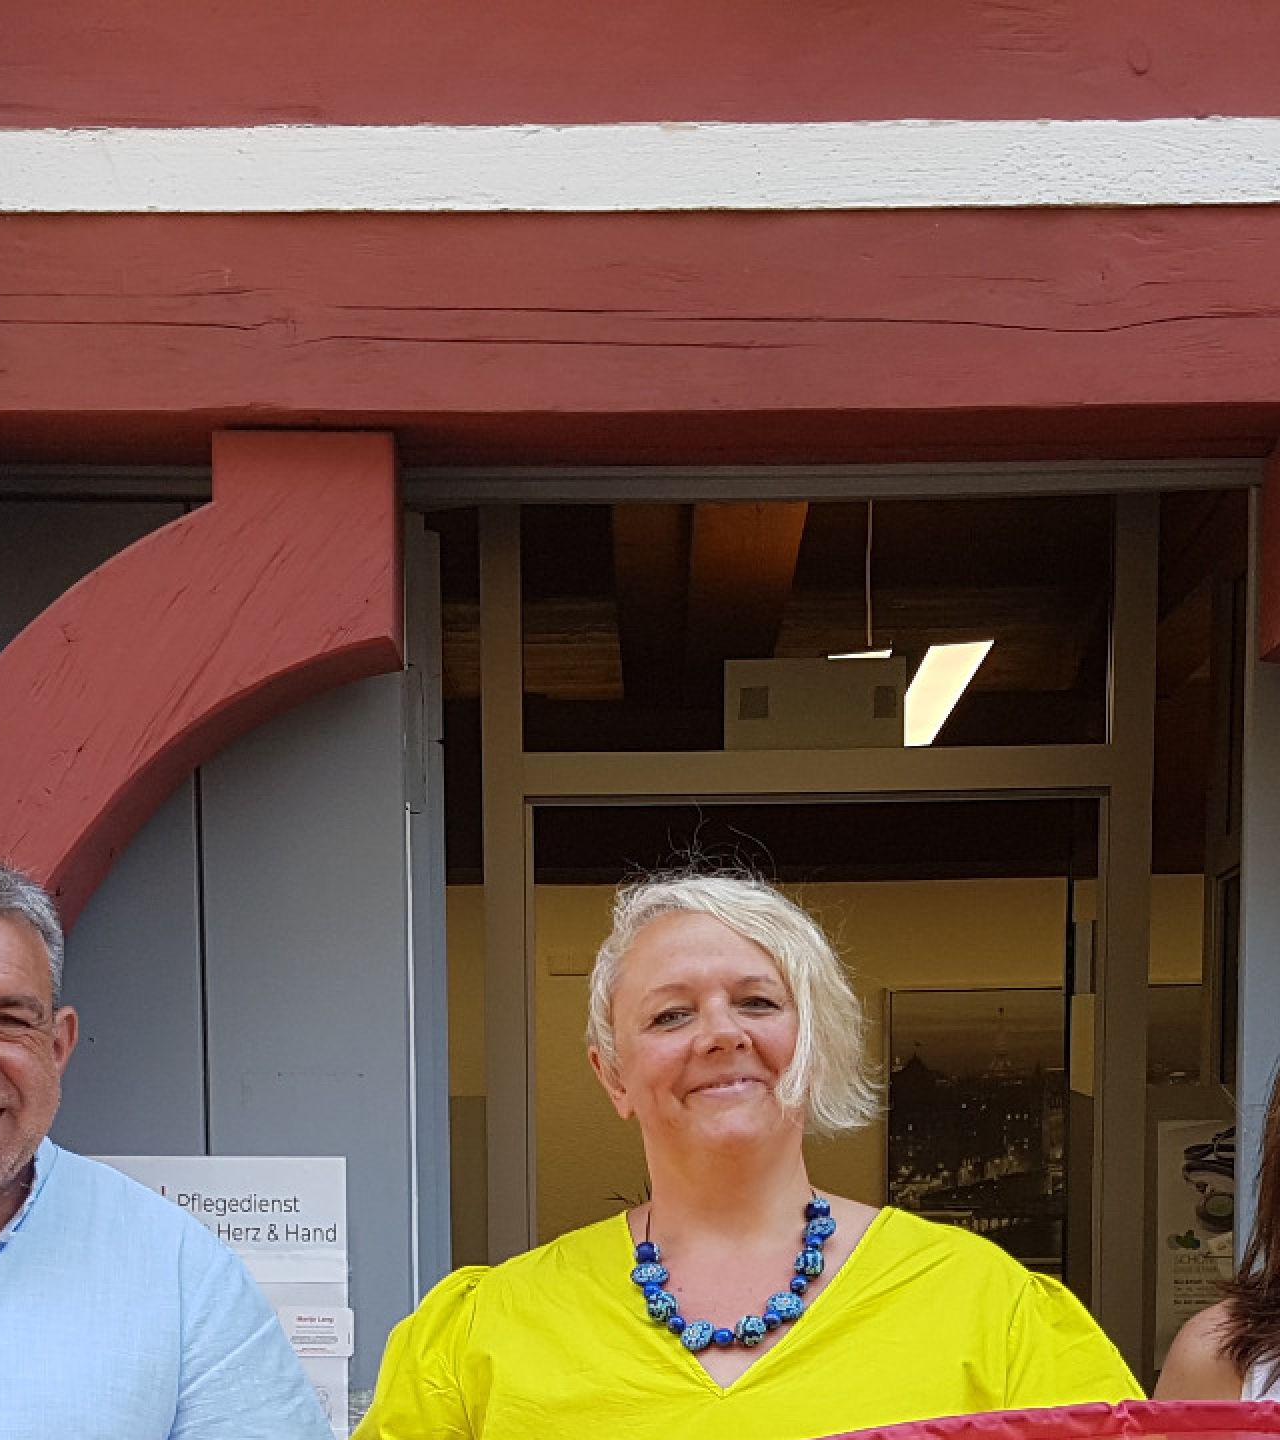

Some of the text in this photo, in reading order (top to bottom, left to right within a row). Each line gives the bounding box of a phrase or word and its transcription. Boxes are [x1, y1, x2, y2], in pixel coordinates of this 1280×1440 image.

[177, 1191, 300, 1217] Pflegedienst
[217, 1223, 337, 1243] Herz & Hand
